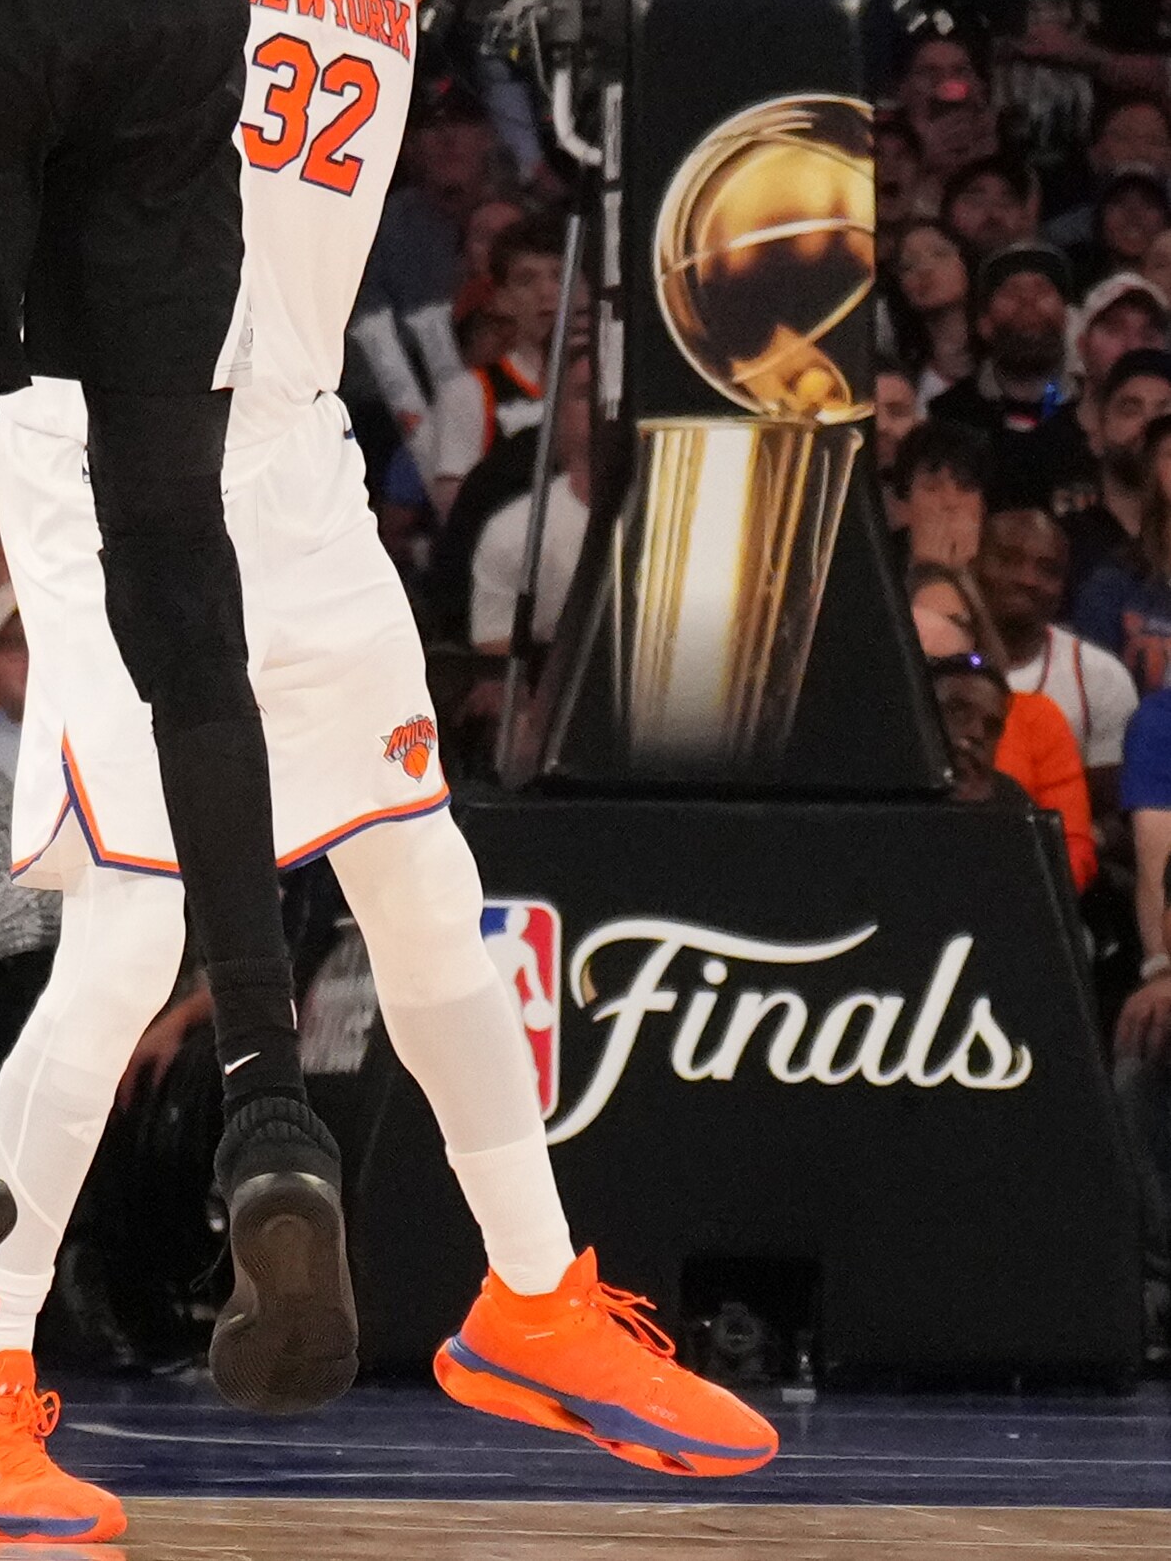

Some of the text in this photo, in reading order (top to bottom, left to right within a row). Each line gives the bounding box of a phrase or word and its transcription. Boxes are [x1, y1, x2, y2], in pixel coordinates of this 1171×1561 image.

[239, 32, 380, 197] 32
[384, 716, 436, 763] KNICKS
[547, 918, 1033, 1145] Finals
